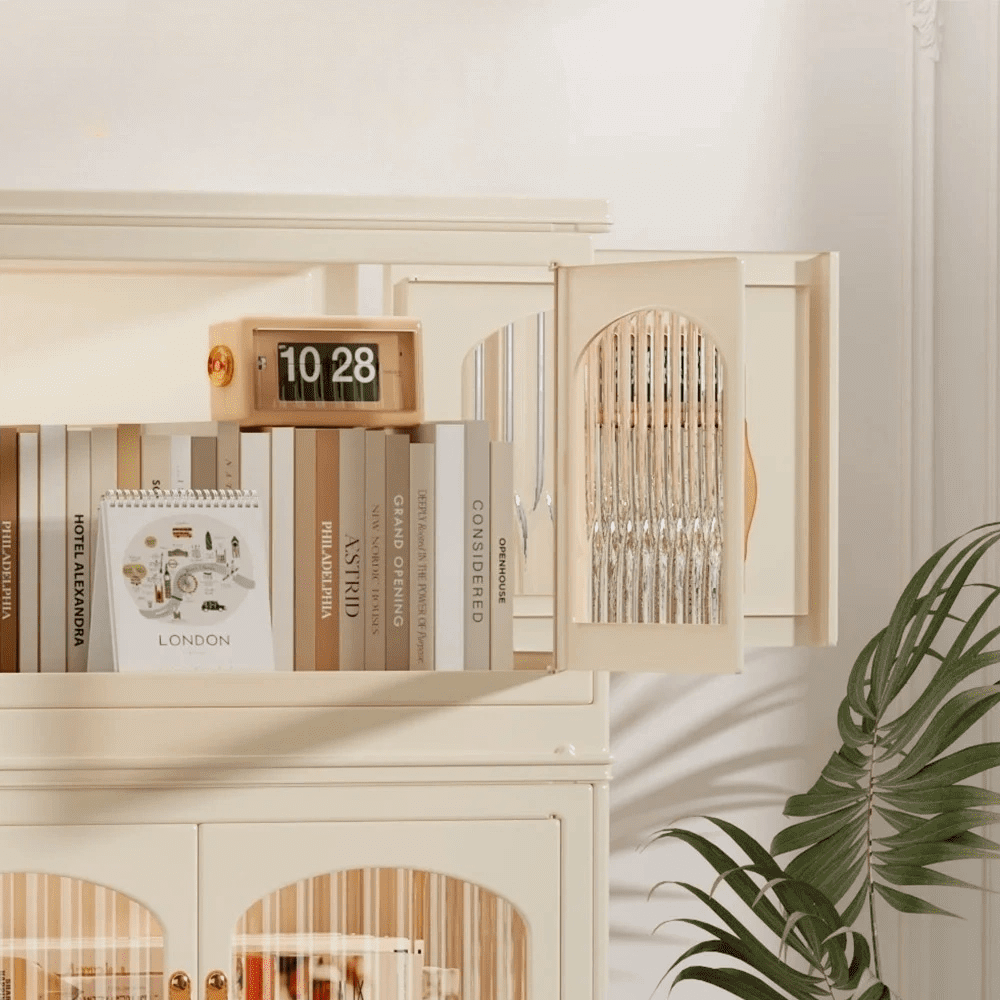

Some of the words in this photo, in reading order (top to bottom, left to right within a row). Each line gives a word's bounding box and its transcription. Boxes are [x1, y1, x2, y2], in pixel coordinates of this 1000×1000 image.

[279, 346, 321, 383] 10
[331, 346, 376, 384] 28
[74, 514, 84, 560] HOTEL
[393, 494, 404, 549] GRAND
[2, 520, 11, 621] PHILADELPHIA
[321, 520, 333, 620] PHILADELPHIA
[344, 534, 360, 618] ASTRID
[393, 556, 404, 628] OPENING
[472, 500, 483, 623] CONSIDERED
[498, 537, 506, 604] OPENHOUSE
[74, 563, 84, 647] ALEXANDRA
[158, 634, 231, 647] LONDON
